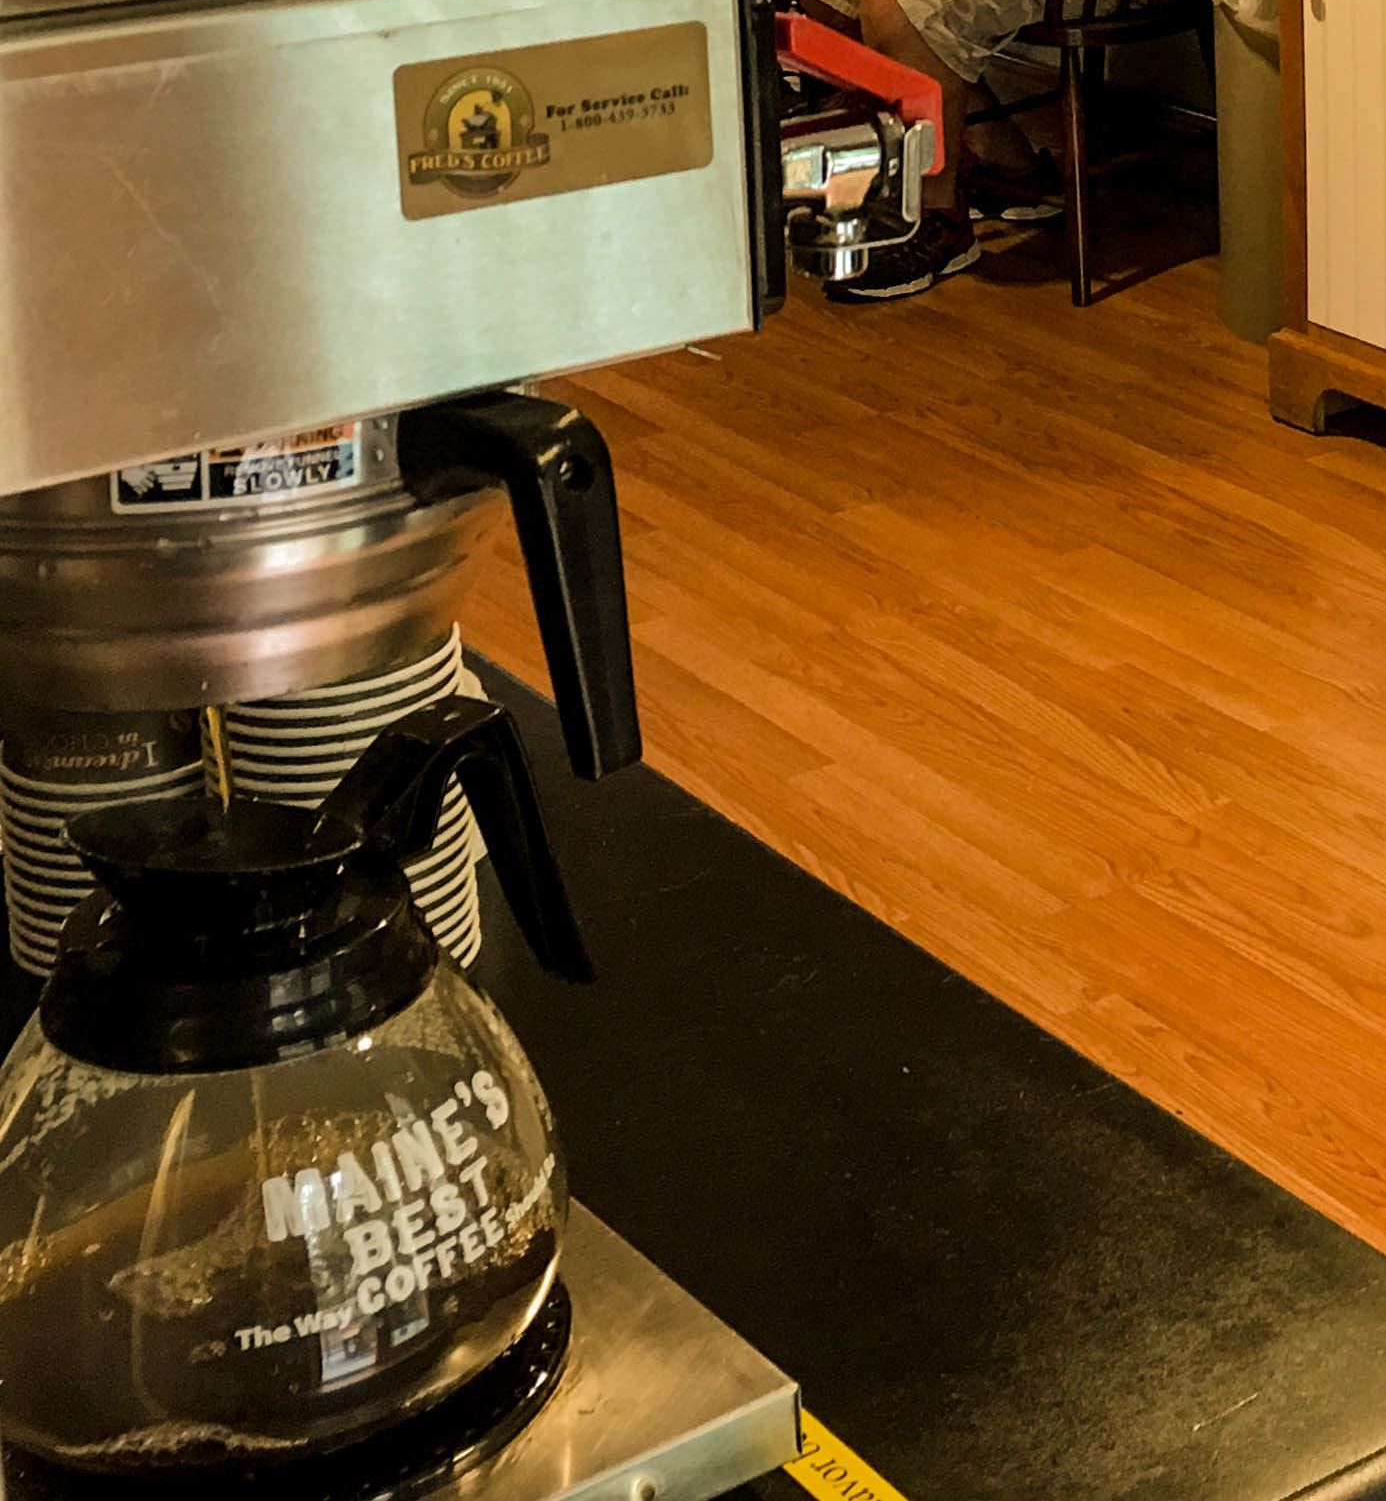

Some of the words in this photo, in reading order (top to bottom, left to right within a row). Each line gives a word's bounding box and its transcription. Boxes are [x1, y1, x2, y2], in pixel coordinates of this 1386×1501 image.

[546, 104, 576, 119] For
[581, 93, 645, 112] Service
[650, 84, 690, 101] Call:
[481, 147, 545, 170] COFFEE
[233, 464, 332, 496] SLOWLY
[262, 1070, 509, 1242] MAINE'S
[343, 1156, 489, 1276] BEST
[234, 1325, 292, 1351] The
[294, 1305, 353, 1337] Way
[357, 1206, 505, 1315] COFFEE
